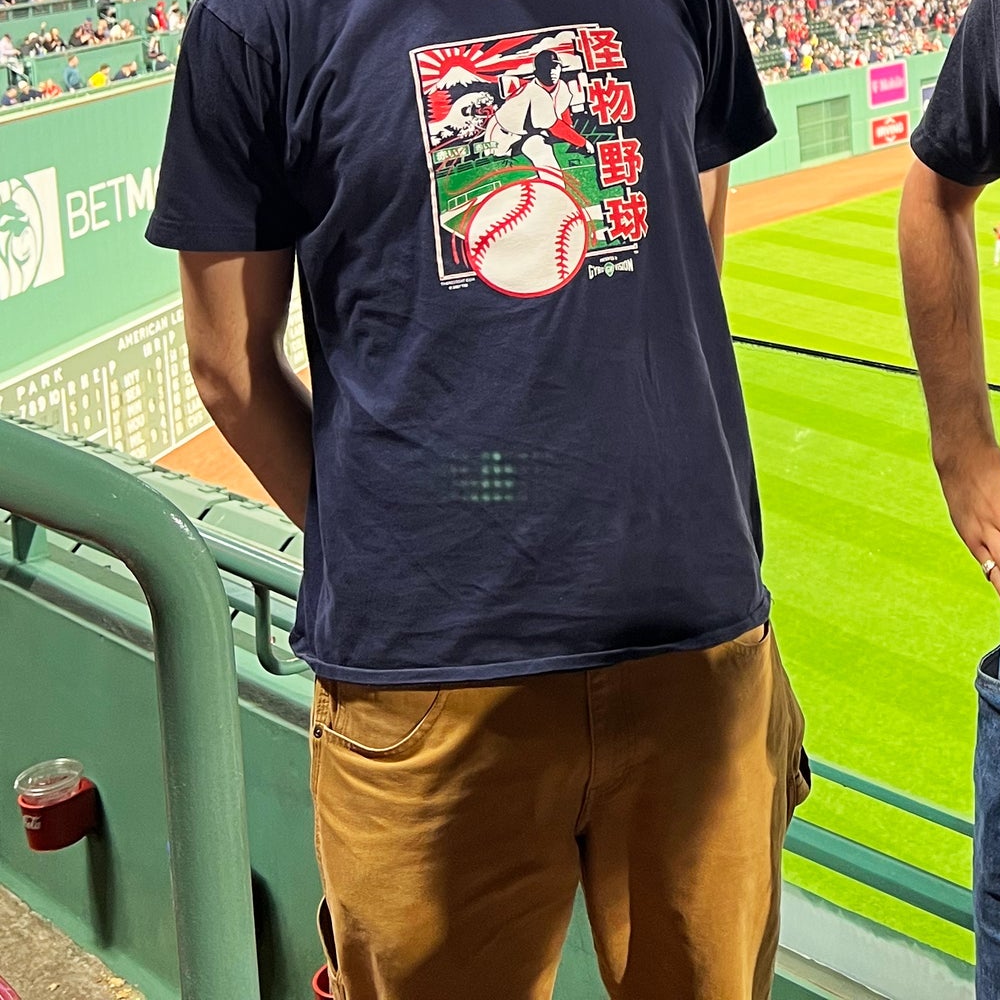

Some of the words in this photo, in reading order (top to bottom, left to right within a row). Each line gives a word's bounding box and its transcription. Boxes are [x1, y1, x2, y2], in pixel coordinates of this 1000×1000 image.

[578, 26, 648, 242] 怪物野球
[117, 315, 168, 353] AMERICAN
[170, 308, 184, 326] LE
[16, 367, 64, 402] PARK
[92, 367, 102, 384] E
